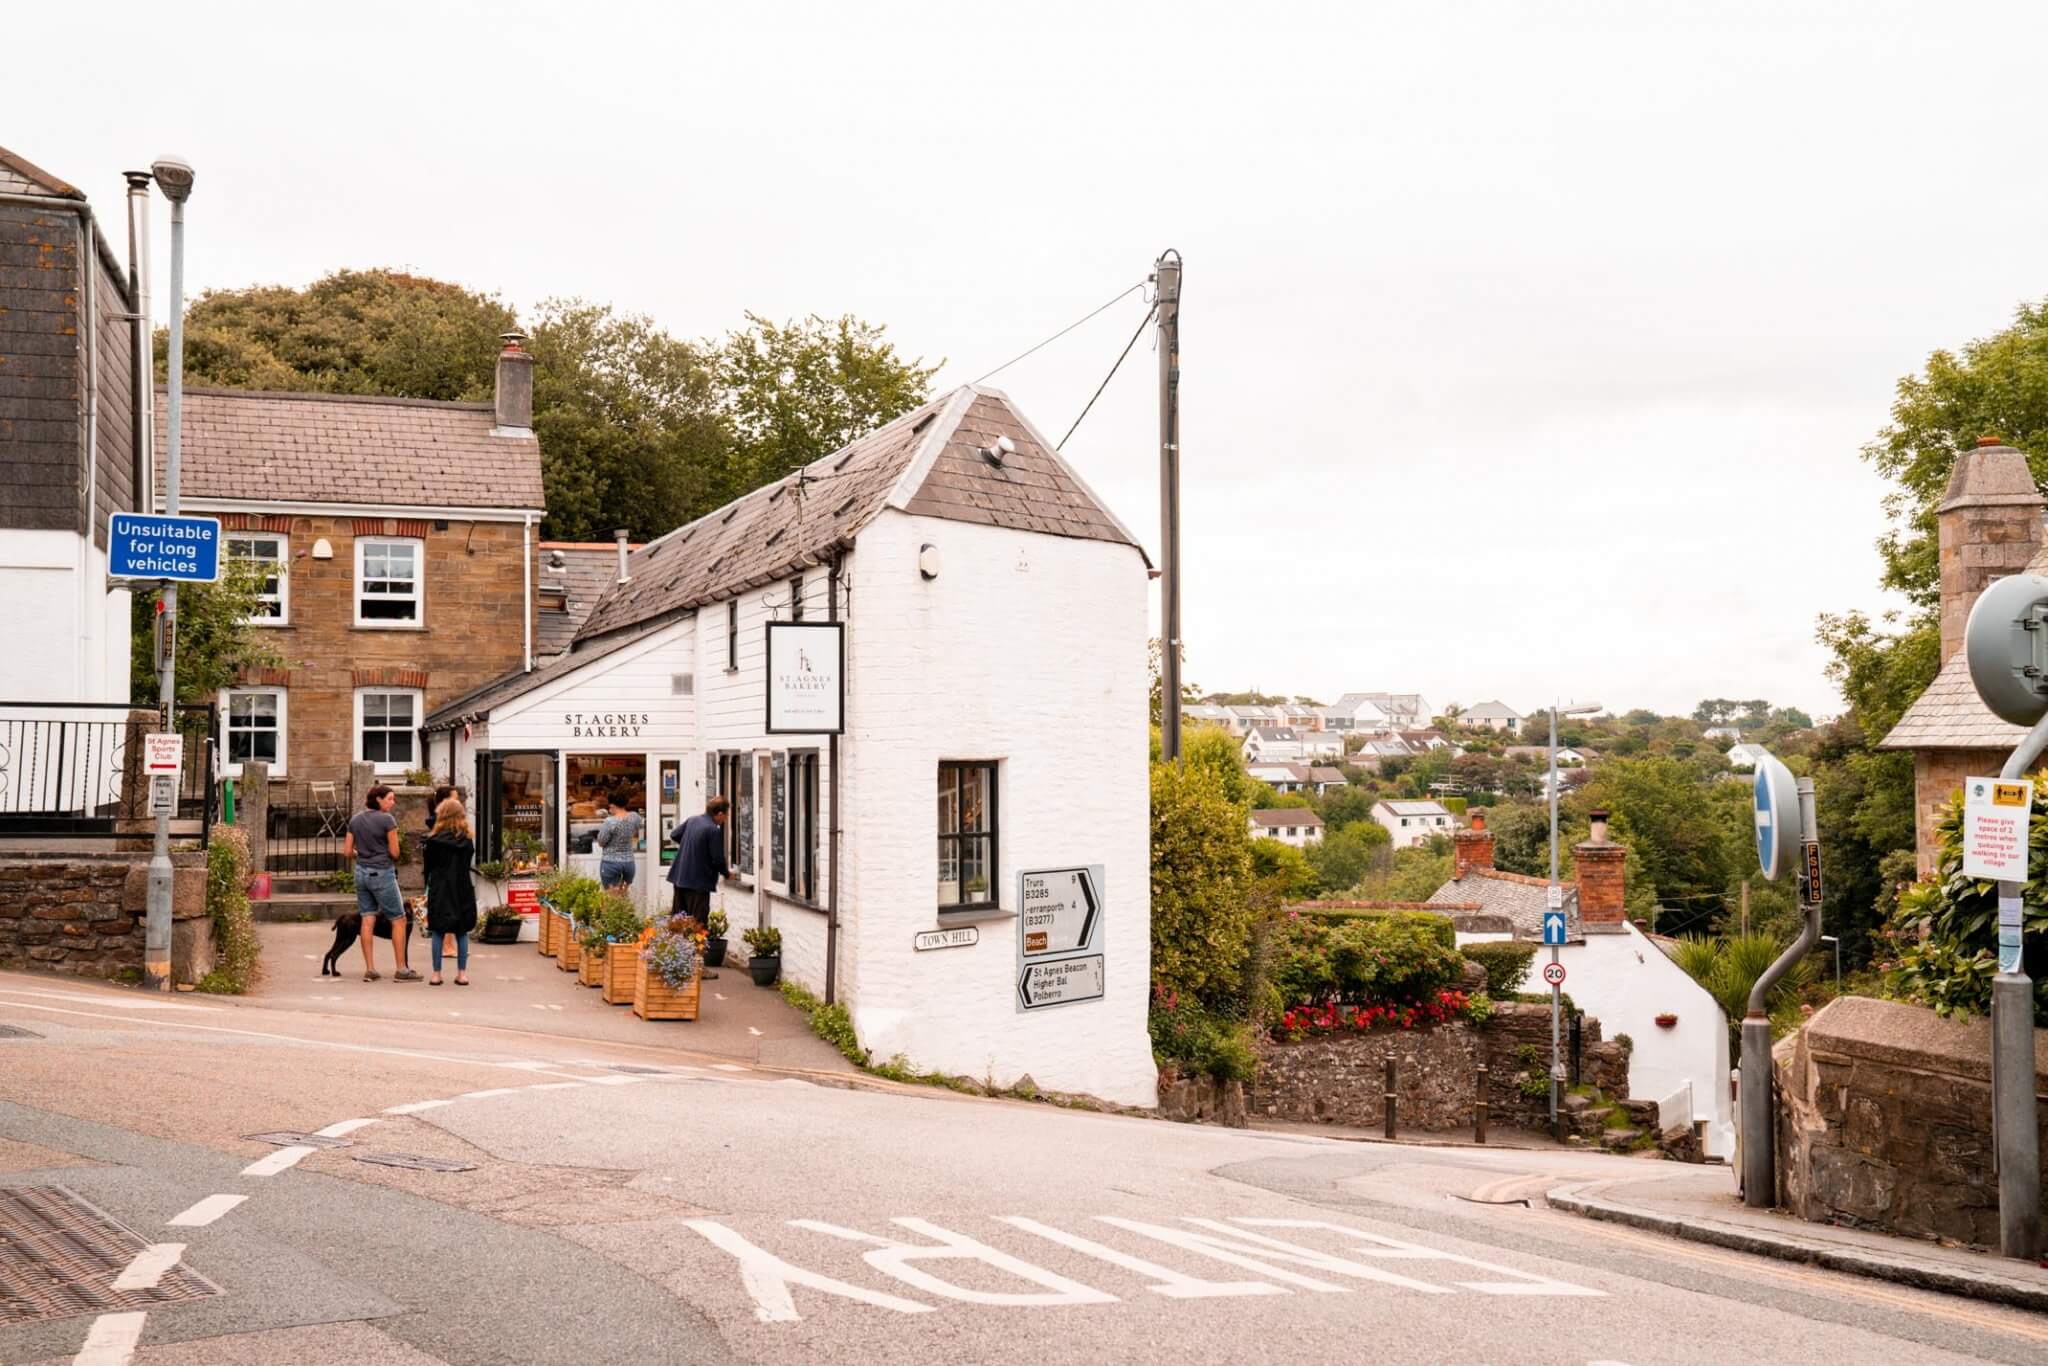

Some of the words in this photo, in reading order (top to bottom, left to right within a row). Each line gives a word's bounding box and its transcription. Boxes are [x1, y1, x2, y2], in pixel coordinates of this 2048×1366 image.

[118, 521, 212, 540] Unsuitable
[130, 539, 154, 553] for
[160, 541, 196, 559] long
[127, 557, 197, 573] vehicles
[573, 726, 641, 737] BAKERY
[2000, 818, 2015, 826] give
[1978, 843, 2005, 851] queuing
[1972, 850, 1998, 858] walking
[1984, 859, 2005, 868] village
[1809, 845, 1820, 900] FS005
[1025, 878, 1044, 888] Truro
[1071, 875, 1076, 884] 9
[1025, 889, 1049, 900] B3285
[1025, 914, 1055, 927] (B3277)
[922, 933, 948, 946] TOWN
[952, 931, 972, 943] HILL
[1026, 935, 1047, 947] Beach
[1033, 967, 1042, 977] St
[1043, 966, 1063, 977] Agnes
[1064, 963, 1087, 973] Beacon
[1547, 969, 1563, 978] 20
[1033, 979, 1055, 990] Higher
[1057, 976, 1068, 985] Bal
[1033, 990, 1062, 1001] Polberro
[683, 1217, 1608, 1322] ENTRY
